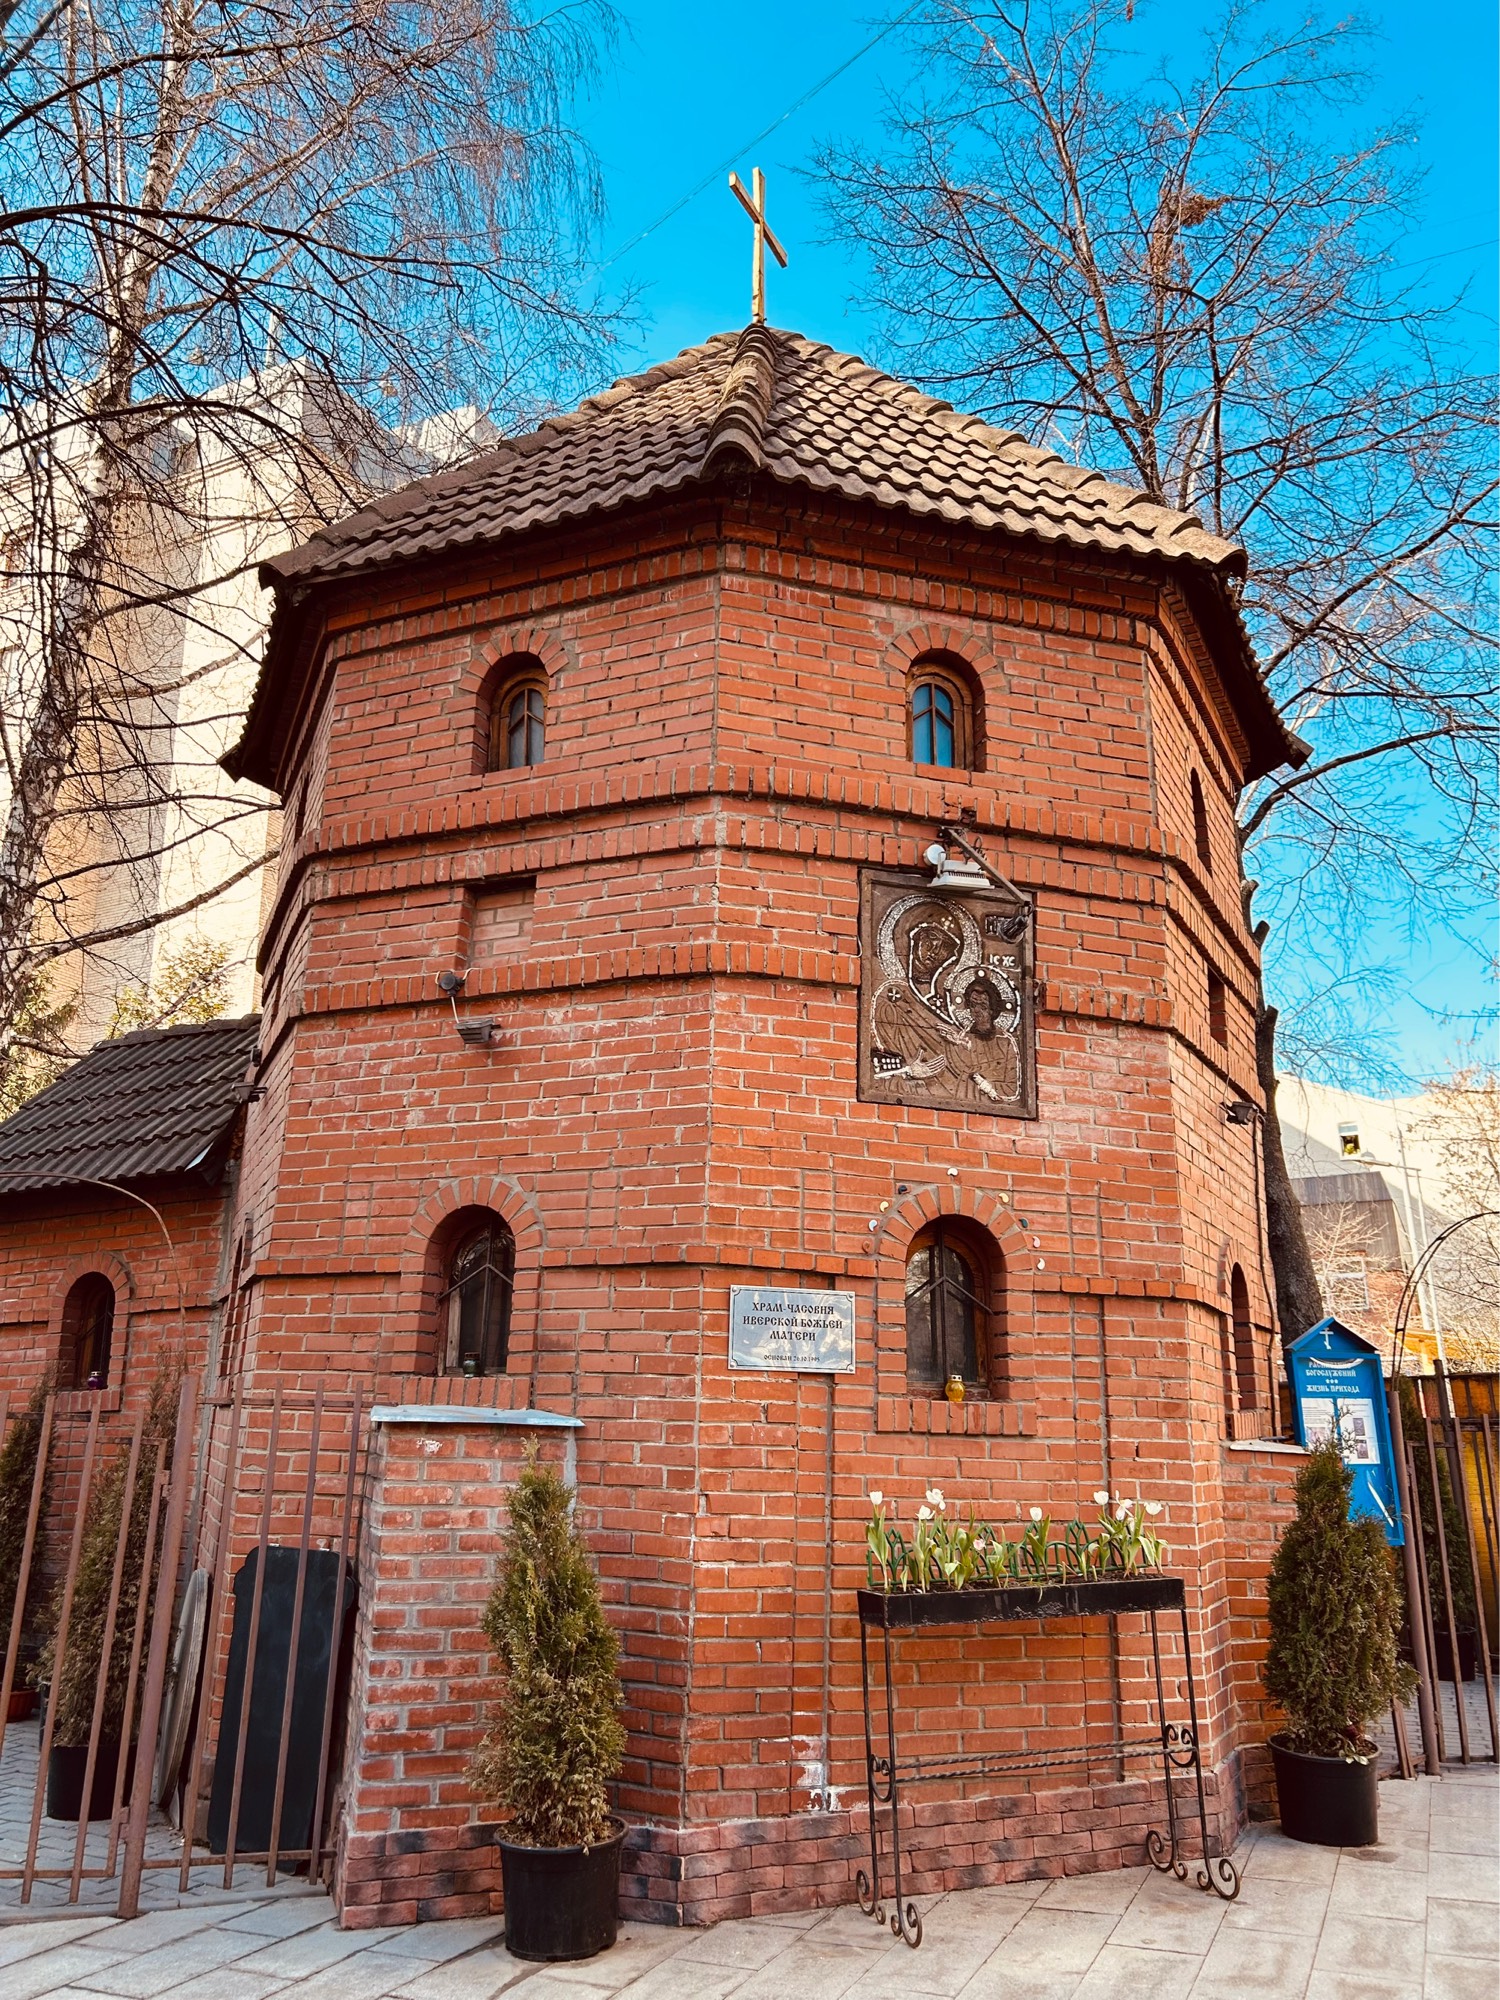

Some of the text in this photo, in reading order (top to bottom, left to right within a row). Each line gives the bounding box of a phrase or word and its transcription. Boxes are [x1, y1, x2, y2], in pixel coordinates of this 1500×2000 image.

[752, 1302, 834, 1315] ХРАМ-ЧАСОВНЯ
[743, 1315, 843, 1329] ИВЕРСКОЙ БОЖЬЕЙ
[769, 1330, 816, 1341] МАТЕРИ
[1305, 1369, 1356, 1377] БОГОСЛУЖЕНИЙ
[1330, 1385, 1360, 1393] ПРИХОДА
